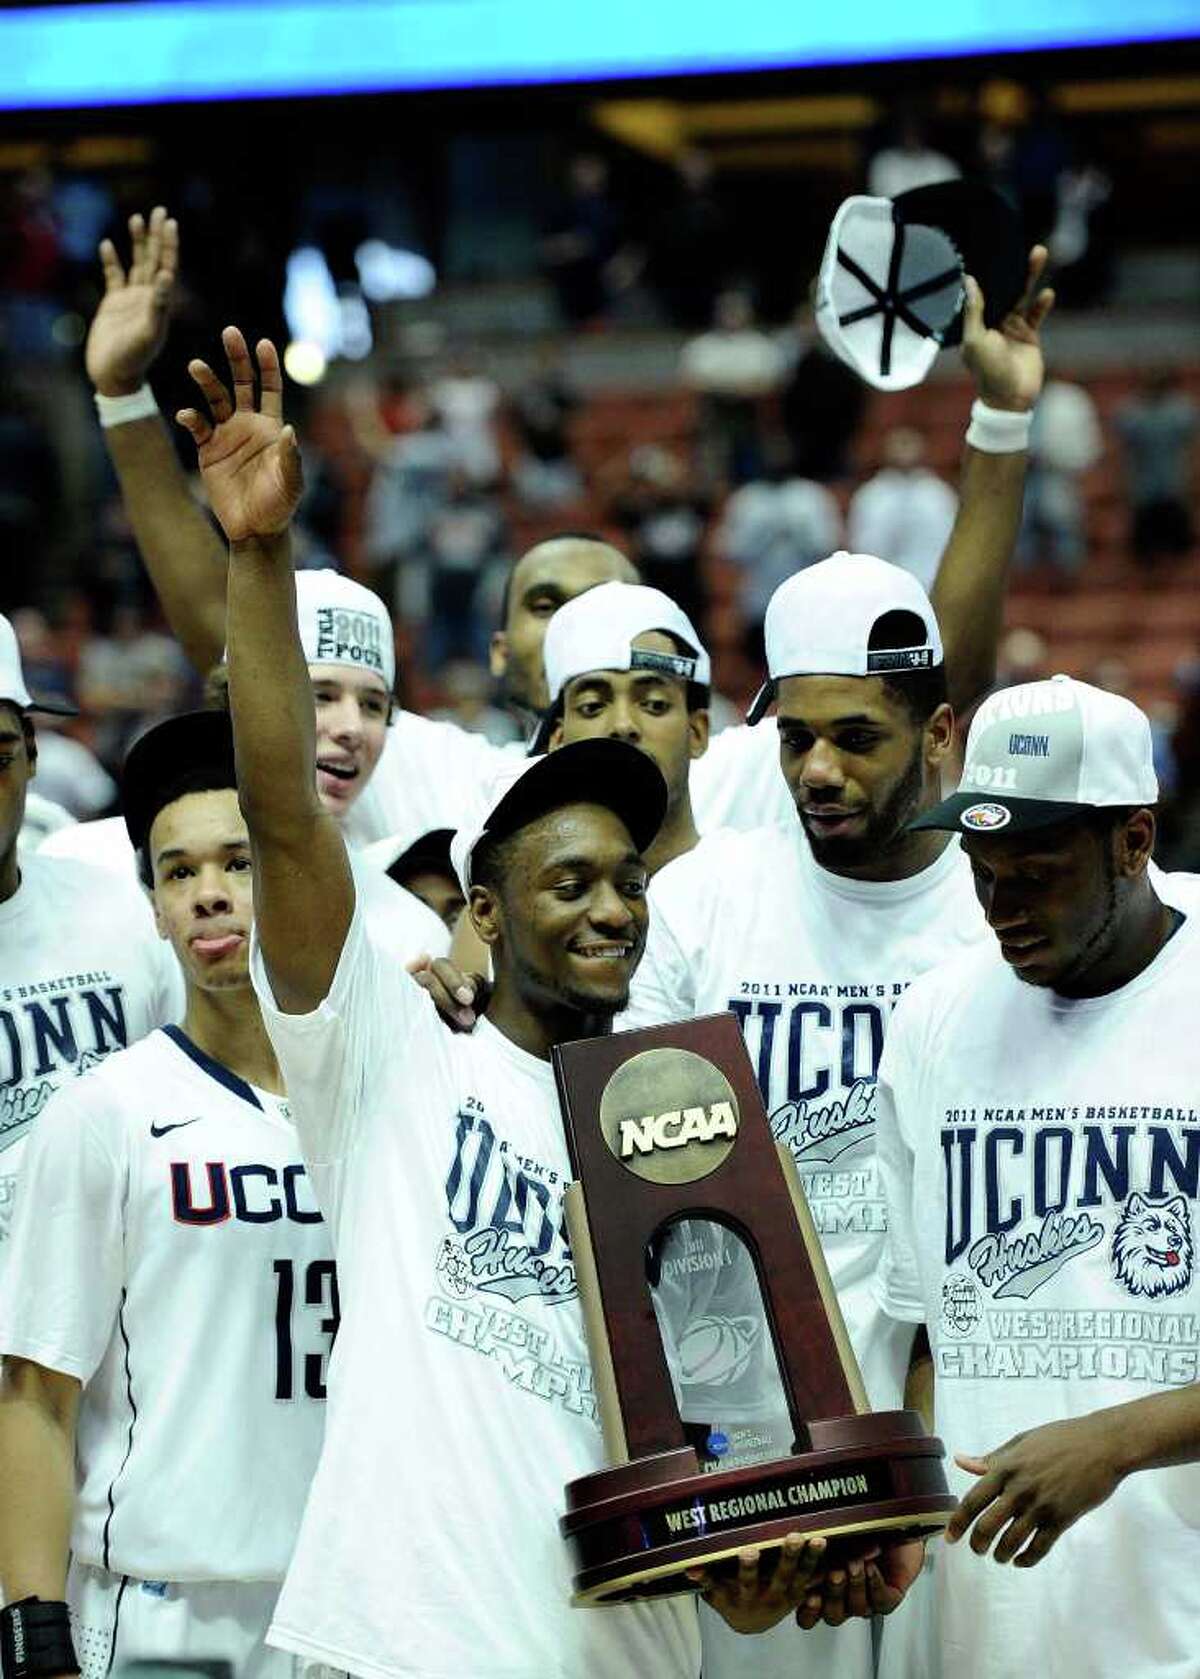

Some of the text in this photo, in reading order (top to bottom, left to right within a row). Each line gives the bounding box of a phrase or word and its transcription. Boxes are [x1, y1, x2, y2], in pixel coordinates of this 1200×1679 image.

[18, 970, 112, 998] BASKETBALL
[741, 982, 781, 996] 2011
[836, 984, 884, 998] MEN'S
[620, 1102, 736, 1157] NCAA
[945, 1106, 1200, 1122] 2011 NCAA MEN'S BASKETBALL
[940, 1126, 1200, 1266] UCONN
[968, 1211, 1106, 1288] Huskies
[937, 1345, 1198, 1385] CHAMPIONS
[665, 1475, 869, 1532] WEST REGIONAL CHAMPION
